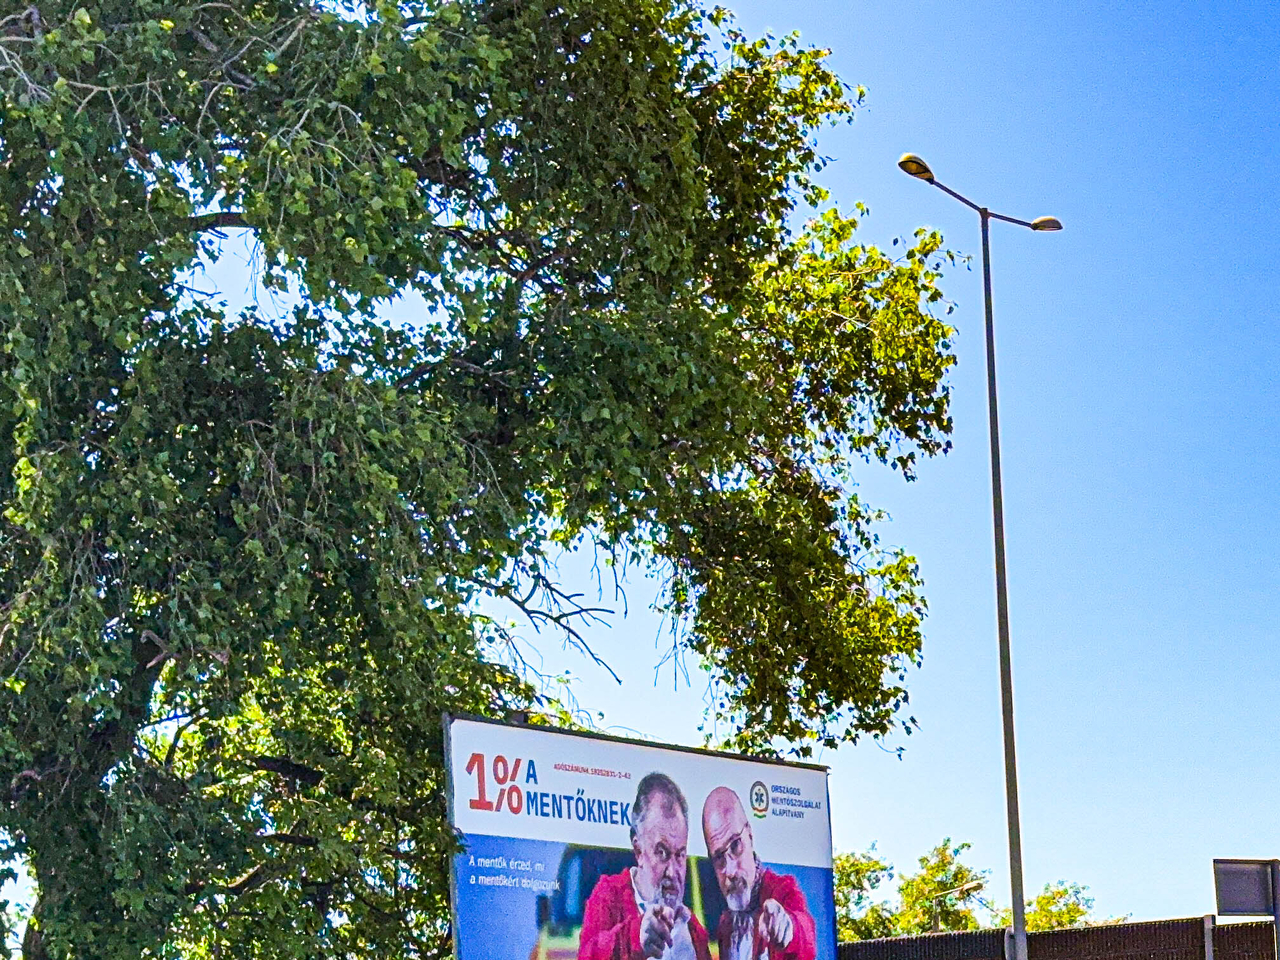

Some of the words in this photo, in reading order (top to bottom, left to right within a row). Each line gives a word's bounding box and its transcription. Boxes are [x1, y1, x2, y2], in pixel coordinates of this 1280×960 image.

[466, 753, 522, 815] 1%
[526, 760, 538, 784] A
[526, 788, 632, 826] MENTŐKNEK
[468, 855, 475, 866] A
[477, 856, 507, 869] mentők
[469, 874, 476, 884] a
[478, 874, 519, 888] mentőkért
